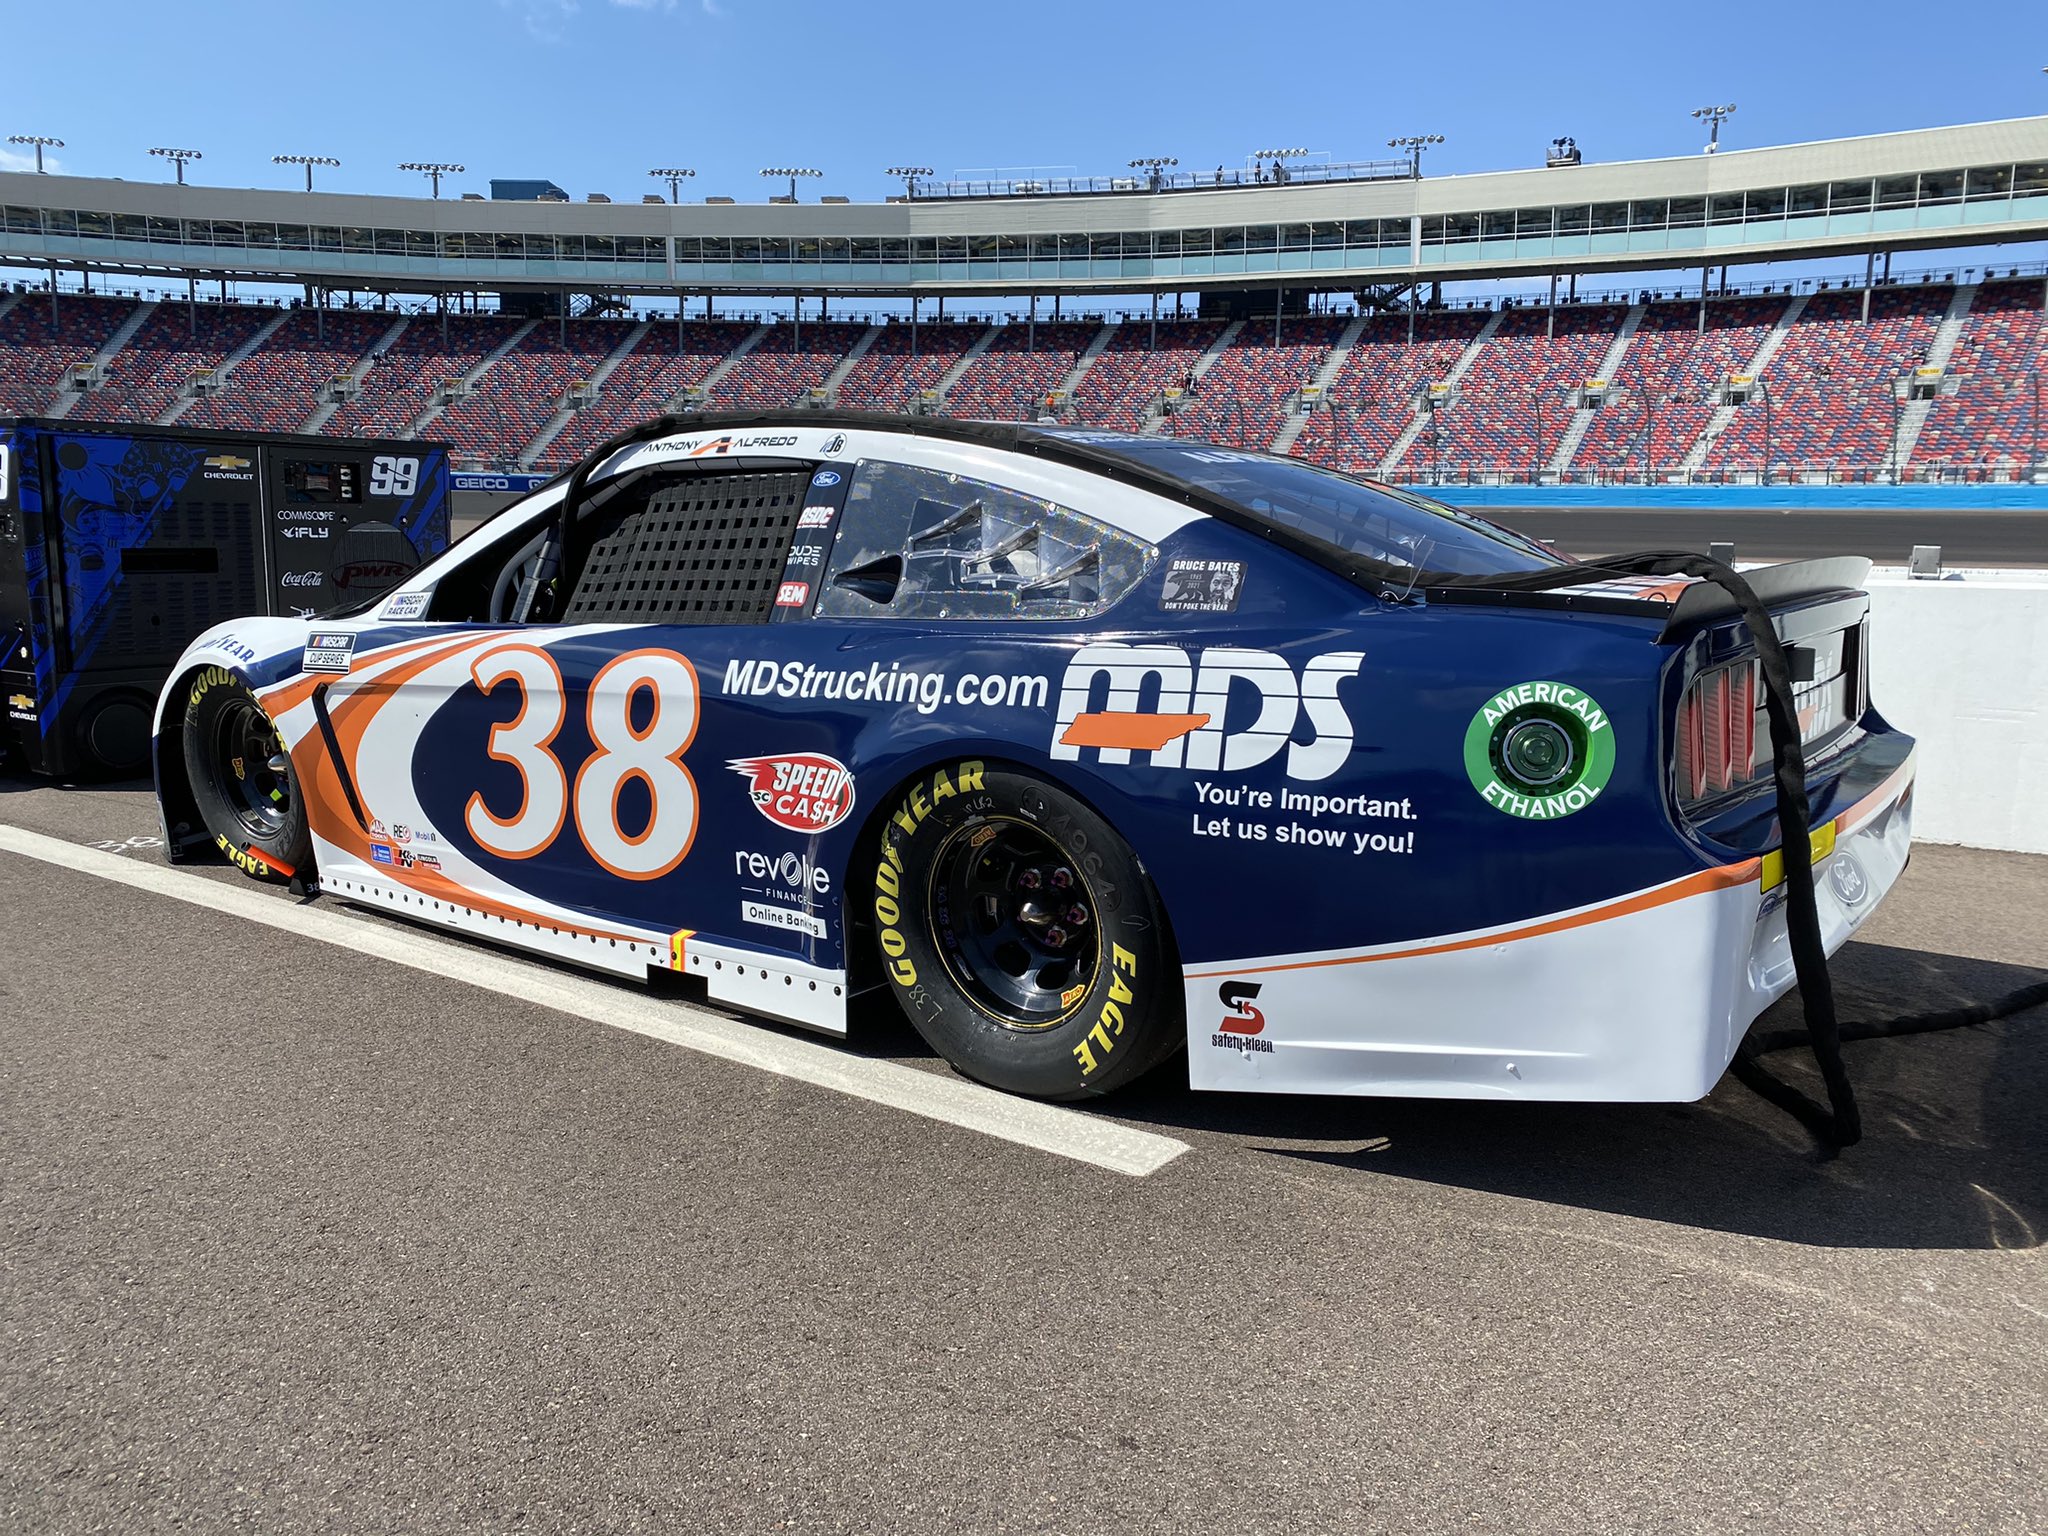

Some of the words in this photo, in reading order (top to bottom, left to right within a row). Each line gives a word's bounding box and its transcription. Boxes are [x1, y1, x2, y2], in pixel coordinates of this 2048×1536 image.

[643, 440, 703, 453] ANTHONY
[733, 436, 798, 447] ALFREDO
[203, 472, 254, 480] CHEVROLET
[369, 456, 420, 496] 99
[455, 478, 509, 489] GEICO
[277, 510, 335, 521] COMMSCOPE
[788, 546, 822, 557] DUDE
[786, 557, 819, 566] WIPES
[1172, 560, 1206, 570] BRUCE
[1208, 561, 1240, 572] BATES
[777, 585, 806, 603] SEM
[387, 607, 403, 615] RACE
[404, 607, 418, 615] CAR
[1164, 602, 1182, 610] DON'T
[1183, 602, 1199, 610] POKE
[1200, 603, 1211, 611] THE
[1212, 603, 1229, 611] BEAR
[319, 635, 349, 648] NASCAR
[309, 653, 322, 664] CUP
[322, 653, 345, 665] SERIES
[722, 659, 1049, 715] MDStrucking.com
[1482, 683, 1608, 733] AMERICAN
[464, 643, 701, 882] 38
[770, 762, 852, 801] SPEEDY
[753, 792, 770, 802] SC
[1280, 788, 1418, 820] Important.
[1481, 780, 1601, 819] ETHANOL
[1193, 814, 1231, 836] Let
[1238, 822, 1268, 840] us
[1275, 822, 1347, 847] show
[1352, 830, 1415, 856] you!
[216, 833, 270, 876] EAGLE
[735, 850, 830, 893] revolve
[875, 760, 986, 987] GOODYEAR
[306, 882, 320, 893] 38
[766, 888, 808, 905] FINANCE
[750, 906, 784, 924] Online
[786, 913, 819, 936] Banking
[1072, 942, 1137, 1076] EAGLE
